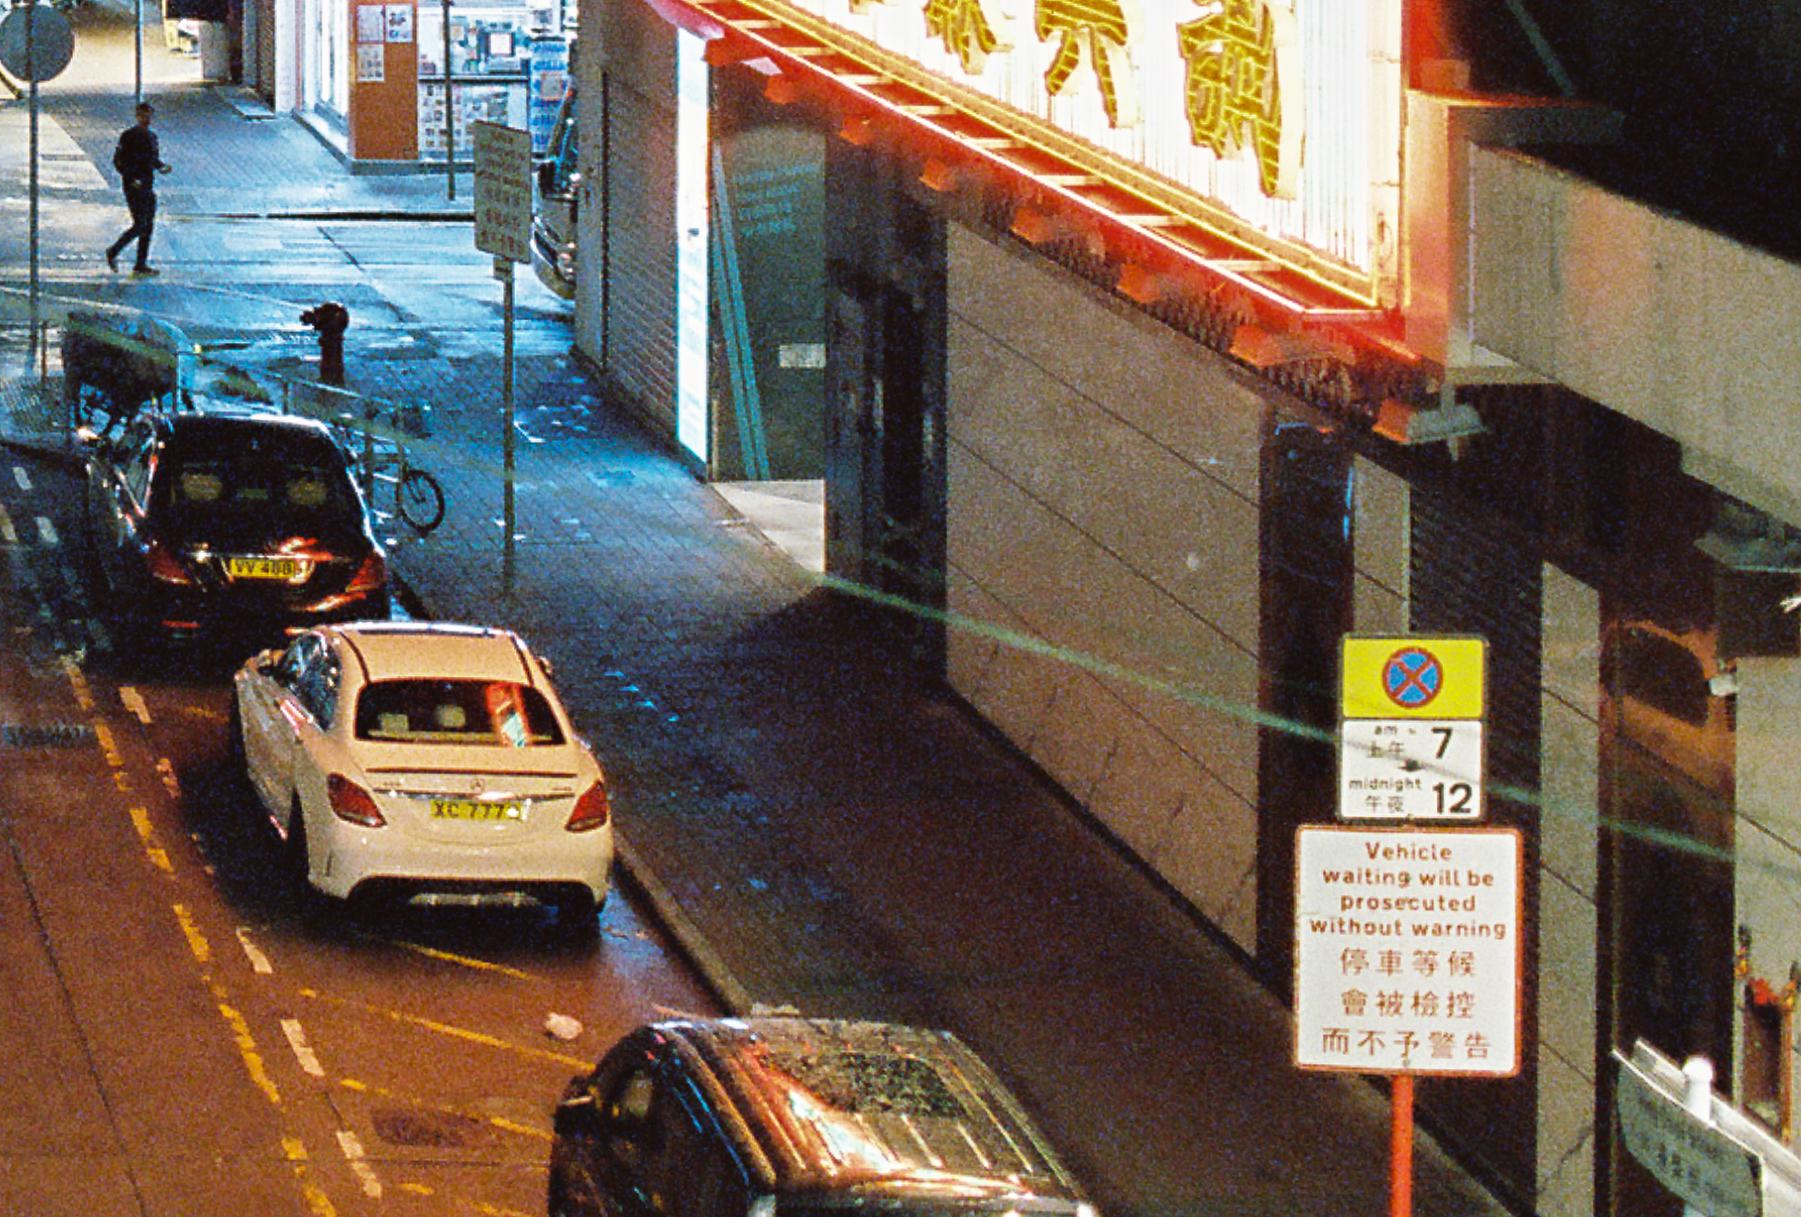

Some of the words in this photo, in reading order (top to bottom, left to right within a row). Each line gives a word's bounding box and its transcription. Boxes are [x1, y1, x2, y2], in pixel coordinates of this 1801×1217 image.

[1367, 740, 1405, 759] 上午
[1374, 725, 1398, 735] am
[1431, 726, 1453, 760] 7
[1349, 777, 1423, 792] midnight
[1432, 782, 1473, 815] 12
[1365, 795, 1405, 814] 午夜
[1365, 841, 1453, 861] Vehicle
[1322, 868, 1411, 889] waiting
[1419, 869, 1461, 886] will
[1467, 869, 1495, 887] be
[1340, 894, 1477, 913] prosecuted
[1309, 916, 1403, 937] without
[1411, 920, 1508, 941] warning
[1340, 946, 1479, 978] 停車等候
[1340, 987, 1476, 1019] 會被檢控
[1321, 1027, 1493, 1060] 而不予警告
